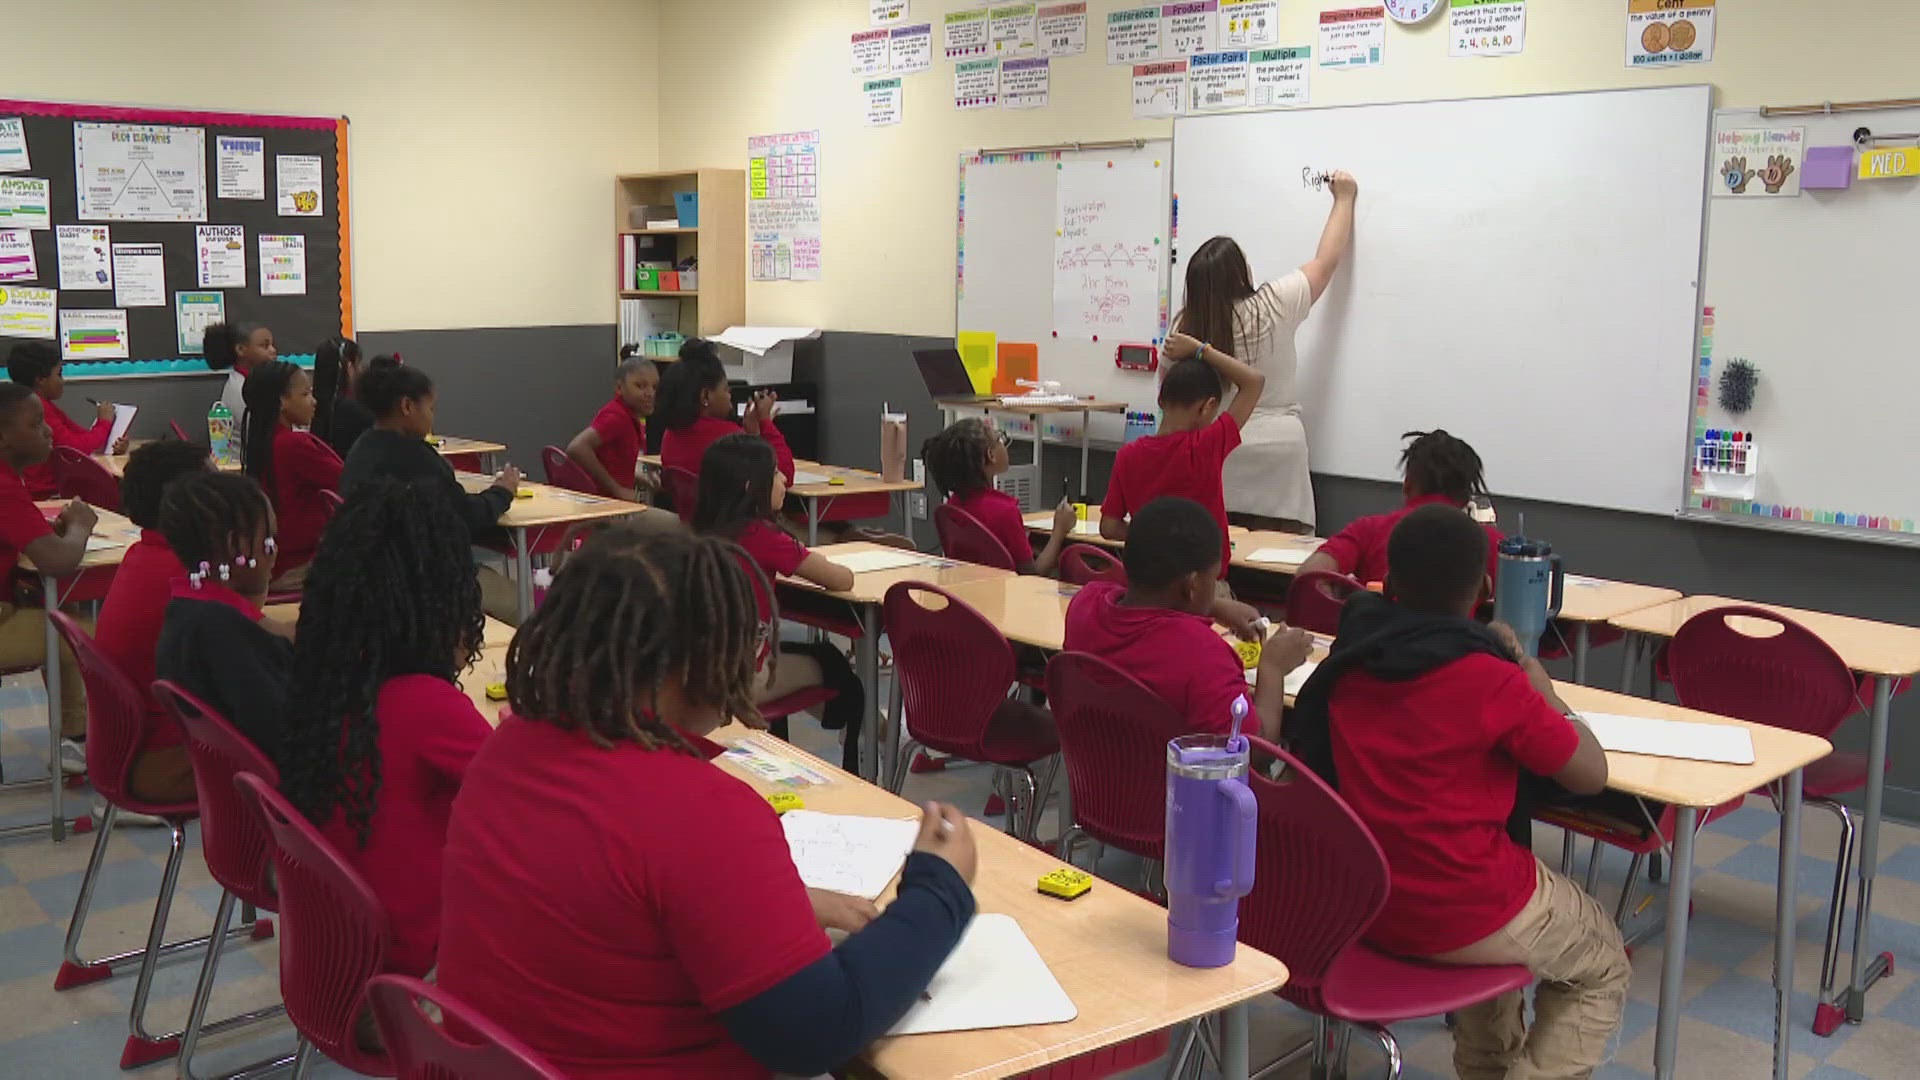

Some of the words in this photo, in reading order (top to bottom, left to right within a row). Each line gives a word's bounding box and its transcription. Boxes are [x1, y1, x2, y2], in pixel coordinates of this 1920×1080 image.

[1172, 3, 1205, 15] Product
[1391, 0, 1396, 8] 8
[1423, 4, 1428, 13] 5
[1112, 10, 1154, 22] Difference
[1399, 8, 1405, 17] 7
[1411, 9, 1417, 19] 6
[1686, 9, 1711, 17] penny
[1453, 18, 1476, 26] divided
[1118, 24, 1132, 32] result
[1471, 25, 1505, 33] remainder
[1503, 35, 1512, 46] 10
[1193, 55, 1218, 65] Factor
[1222, 53, 1243, 62] Pairs
[1262, 50, 1296, 61] Multiple
[1633, 55, 1645, 64] 100
[1647, 54, 1667, 62] cents
[1679, 51, 1702, 60] dollar
[1143, 64, 1175, 75] Quotient
[1268, 64, 1293, 72] product
[1272, 73, 1300, 82] numbers
[1718, 132, 1760, 145] Helping
[1763, 131, 1801, 142] Hands
[1768, 169, 1778, 181] 10
[1, 179, 44, 190] ANSWER
[199, 227, 242, 236] AUTHORS
[201, 248, 209, 258] P
[202, 261, 209, 272] I
[203, 273, 210, 284] E
[11, 288, 51, 300] EXPLAIN
